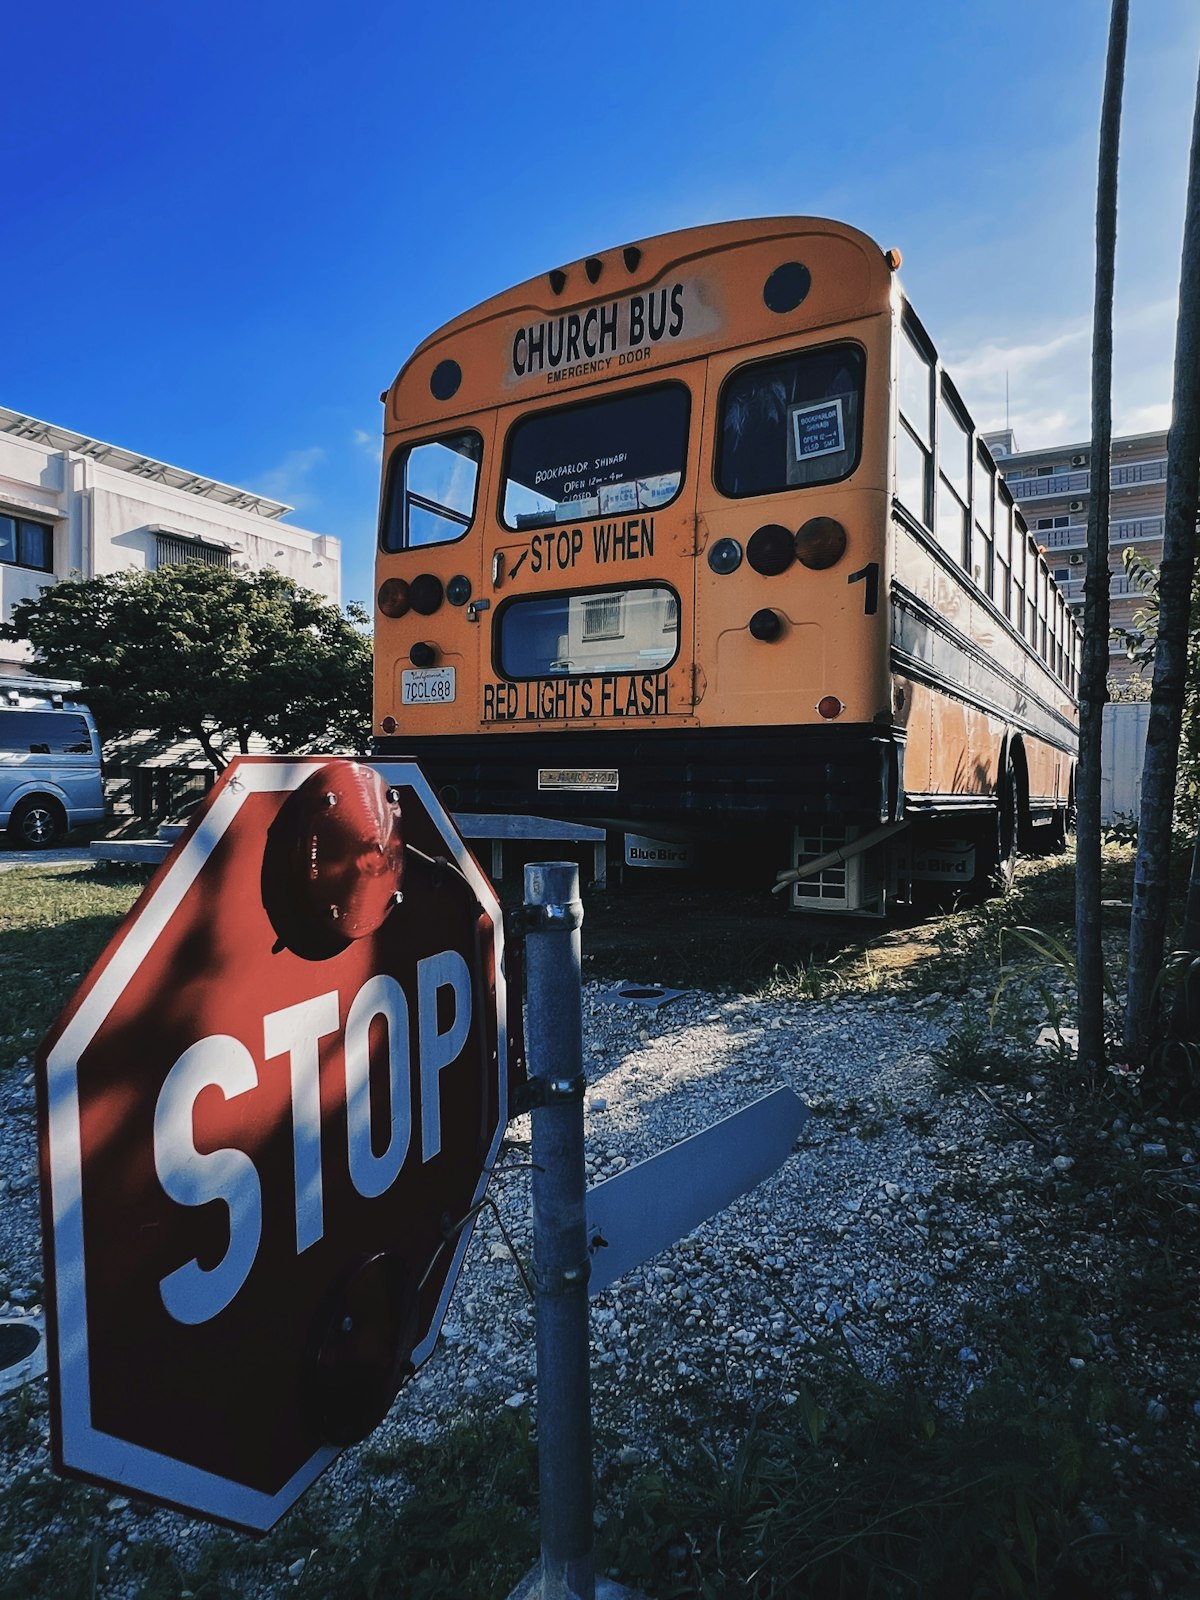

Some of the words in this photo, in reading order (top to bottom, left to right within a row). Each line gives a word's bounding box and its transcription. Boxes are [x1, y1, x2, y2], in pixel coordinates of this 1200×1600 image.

[513, 302, 618, 376] CHURCH
[629, 284, 684, 346] BUS
[547, 357, 613, 384] EMERGENCY
[618, 347, 651, 366] DOOR
[535, 461, 589, 484] BOOKPARLOR
[595, 453, 628, 469] SHINABI
[564, 480, 585, 493] OPEN
[531, 529, 583, 573] STOP
[593, 517, 654, 564] WHEN
[848, 562, 880, 616] 1
[405, 681, 451, 699] 7CCL688
[484, 683, 518, 720] RED
[525, 677, 593, 719] LIGHTS
[601, 674, 668, 716] FLASH
[153, 949, 473, 1326] STOP
